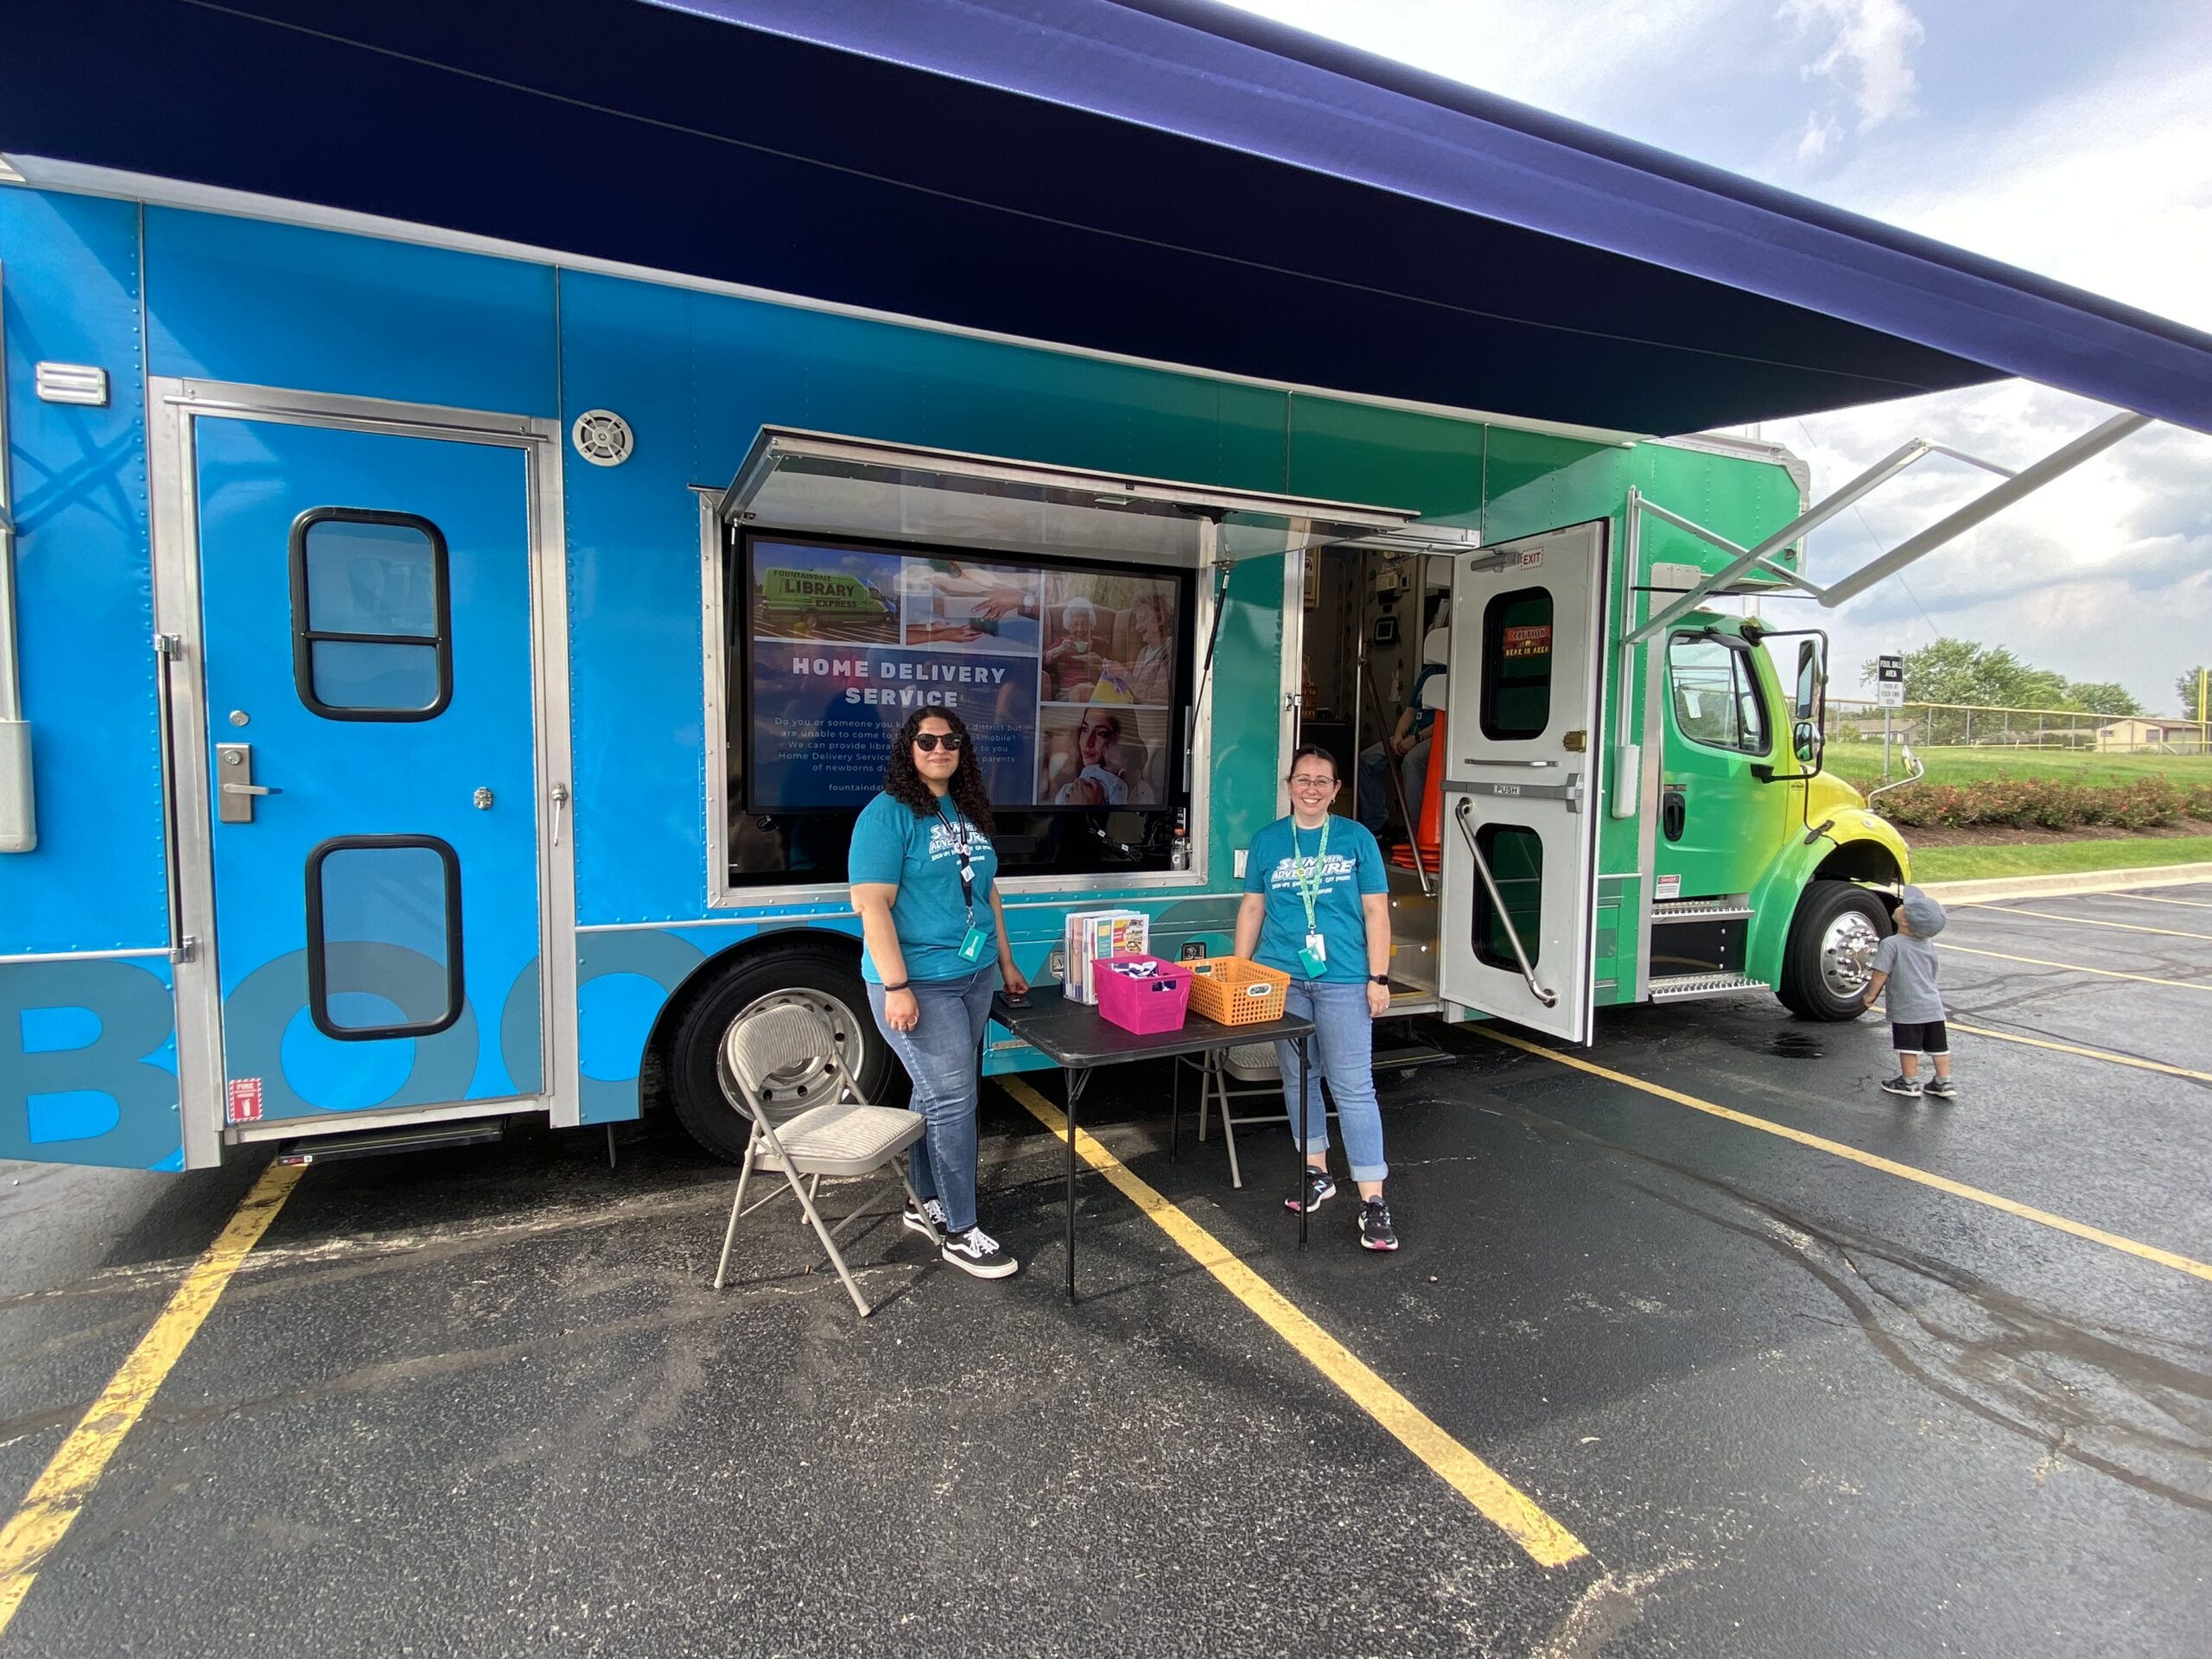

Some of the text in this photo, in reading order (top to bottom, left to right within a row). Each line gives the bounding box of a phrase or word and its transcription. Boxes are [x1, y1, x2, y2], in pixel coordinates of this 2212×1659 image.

[1523, 552, 1541, 565] EXIT
[773, 569, 831, 582] FOUNTAINDALE
[785, 579, 855, 597] LIBRARY
[816, 599, 857, 608] EXPRESS
[1513, 628, 1545, 640] CAUTION
[1533, 645, 1548, 654] AREA
[792, 658, 1006, 683] HOME DELIVERY
[845, 687, 957, 708] SERVICE
[774, 717, 789, 726] Do
[875, 721, 893, 729] you
[801, 729, 836, 738] unable
[787, 741, 804, 749] We
[829, 741, 866, 751] provide
[869, 741, 895, 750] libra
[779, 752, 809, 760] Home
[812, 752, 853, 762] Delivery
[855, 753, 891, 761] Service
[812, 763, 823, 772] of
[829, 783, 885, 791] fountaindal
[1496, 785, 1518, 794] PUSH
[1172, 854, 1180, 864] G
